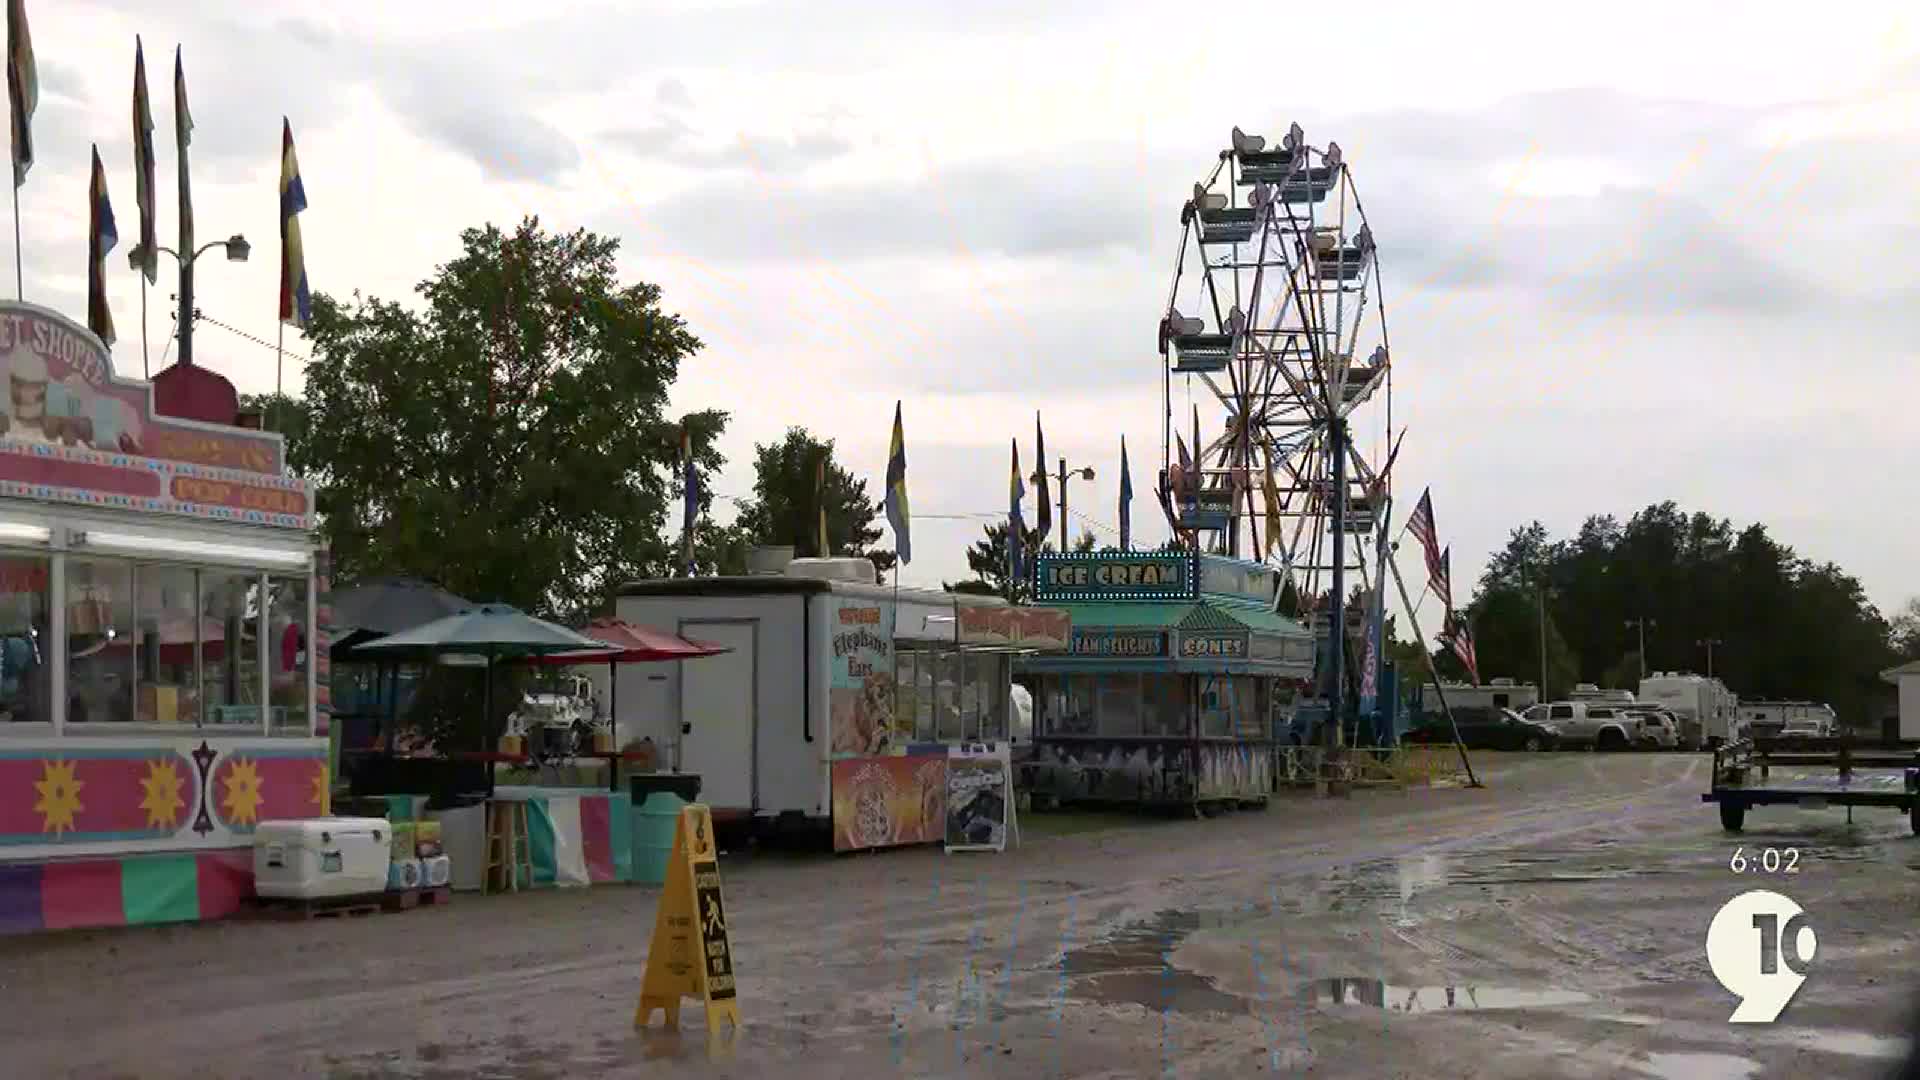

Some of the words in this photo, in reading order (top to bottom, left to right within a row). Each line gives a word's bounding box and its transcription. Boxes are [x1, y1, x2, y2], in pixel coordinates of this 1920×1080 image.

[31, 319, 105, 386] SHOPPE
[1048, 566, 1088, 586] ICE
[1094, 565, 1178, 586] CREAM
[1073, 637, 1099, 655] EAM
[847, 655, 874, 677] Ears
